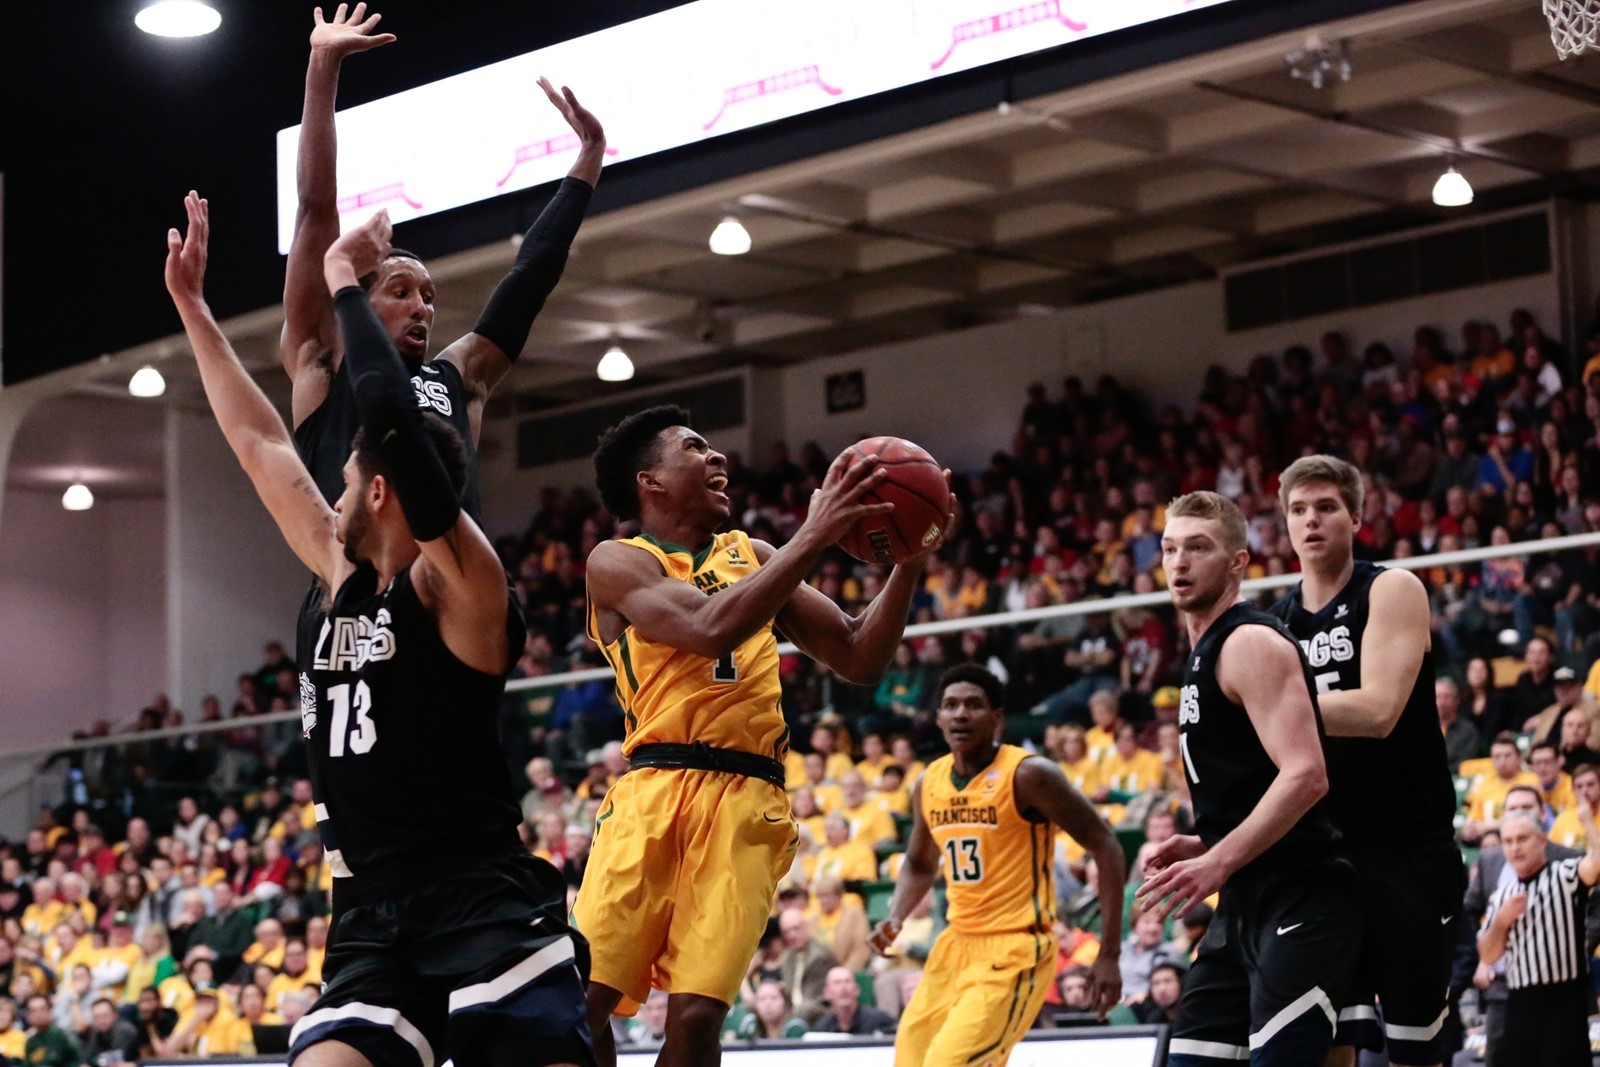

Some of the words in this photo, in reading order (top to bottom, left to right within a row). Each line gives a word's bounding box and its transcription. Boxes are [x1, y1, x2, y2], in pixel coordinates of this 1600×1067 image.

[693, 569, 720, 590] AN
[327, 679, 377, 758] 13
[949, 796, 969, 807] SAN
[929, 804, 998, 827] FRANCISCO
[944, 834, 985, 884] 13
